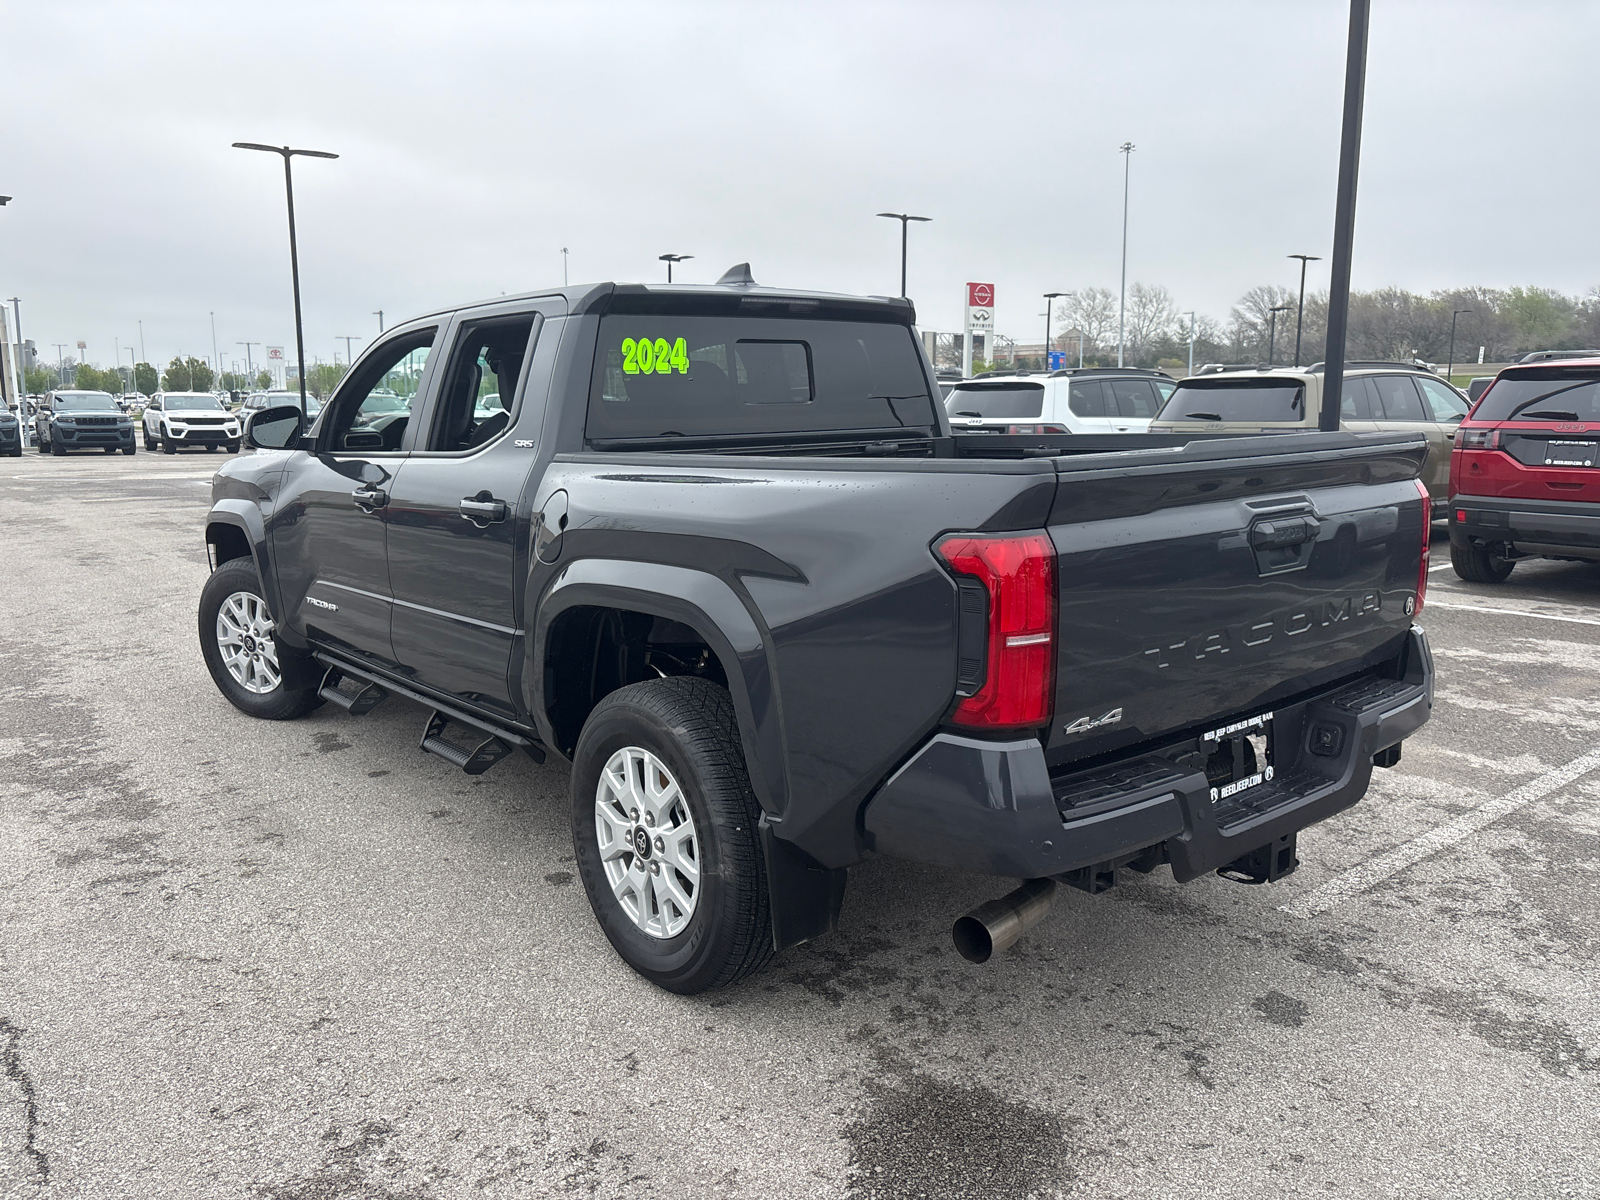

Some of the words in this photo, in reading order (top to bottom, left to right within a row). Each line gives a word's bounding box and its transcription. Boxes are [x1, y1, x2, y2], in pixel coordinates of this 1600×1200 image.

[621, 337, 690, 375] 2024
[1556, 422, 1585, 431] Jeep
[306, 596, 339, 612] TACOMA
[1144, 589, 1383, 668] TACOMA
[1216, 727, 1226, 738] JEEP
[1226, 720, 1248, 734] CHRYSLER
[1248, 715, 1262, 727] DODGE
[1262, 711, 1274, 722] RAM
[1221, 773, 1262, 799] REEDJEEP.COM
